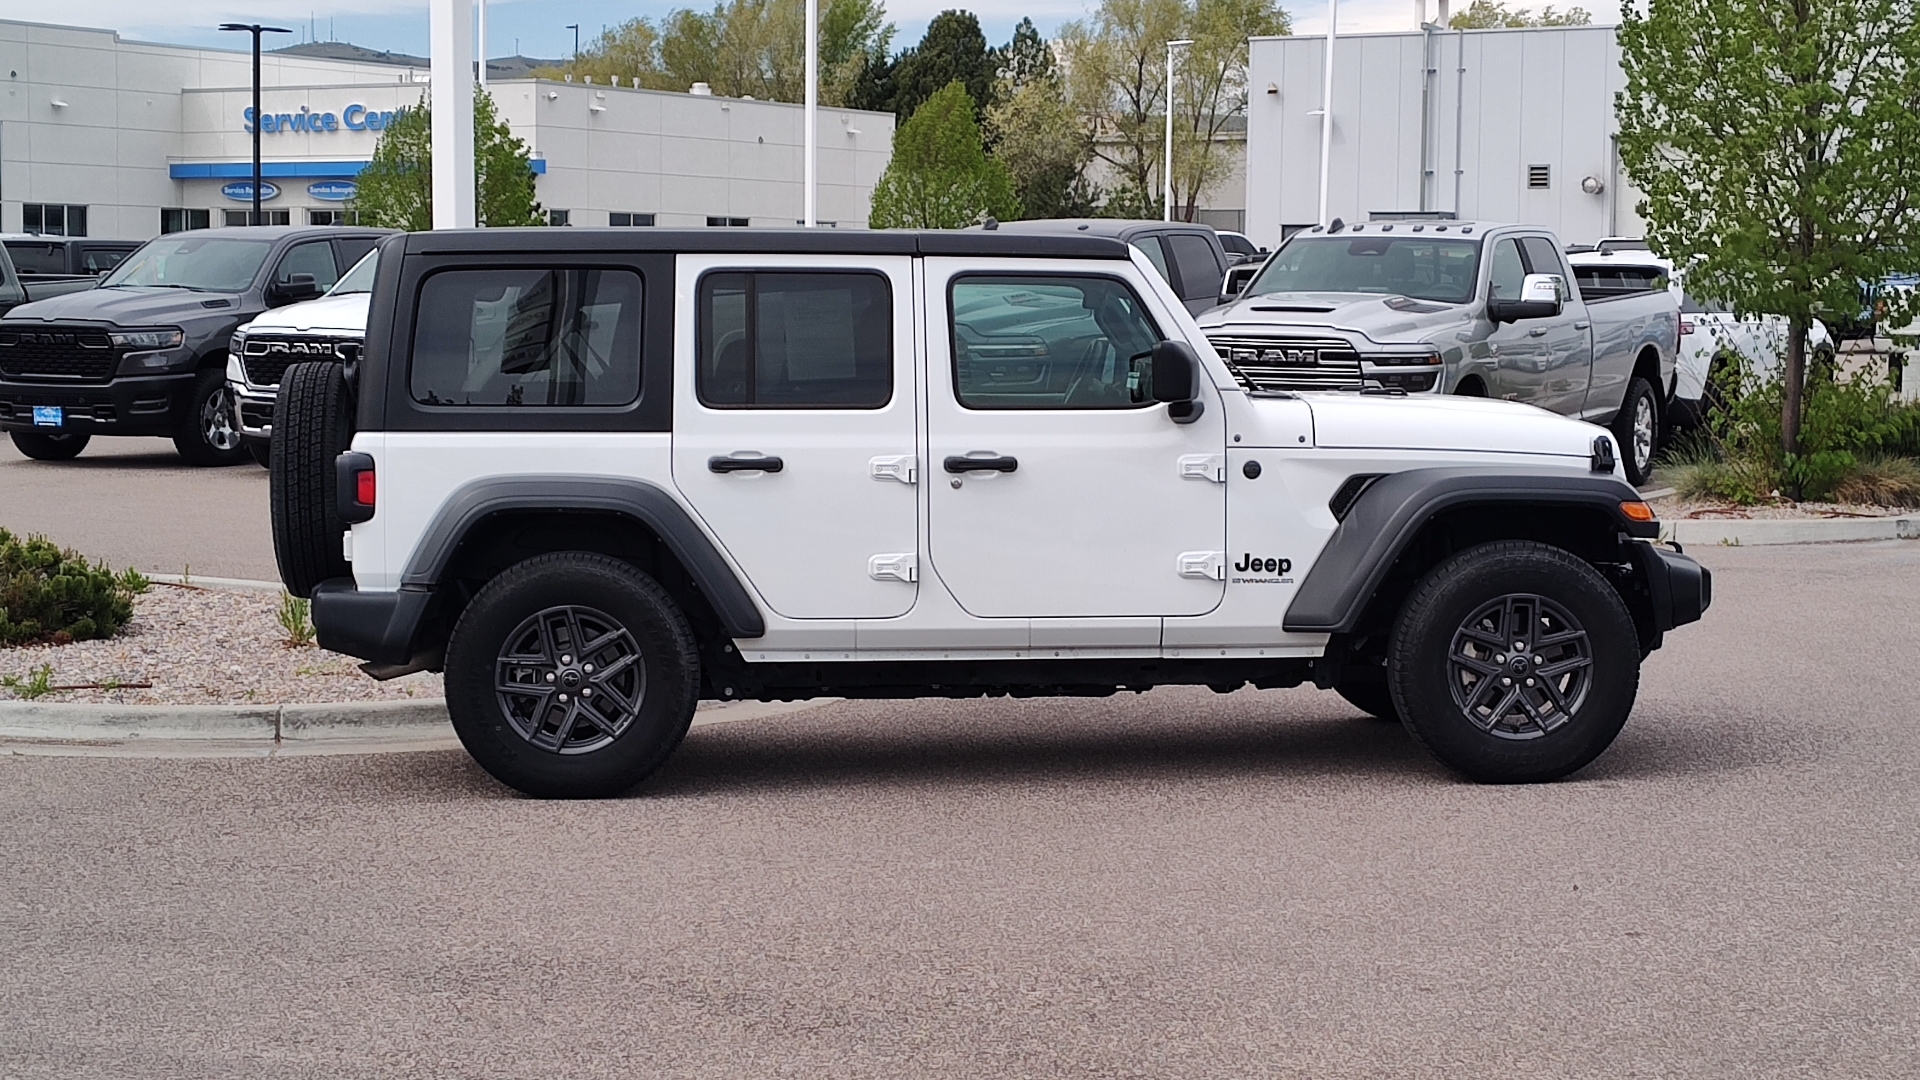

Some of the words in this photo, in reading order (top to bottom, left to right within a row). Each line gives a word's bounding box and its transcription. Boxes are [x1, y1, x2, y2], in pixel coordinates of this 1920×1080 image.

[243, 105, 338, 133] Service
[20, 333, 76, 344] RAM
[271, 342, 332, 354] RAM
[1232, 349, 1315, 362] RAM
[1234, 553, 1292, 577] Jeep
